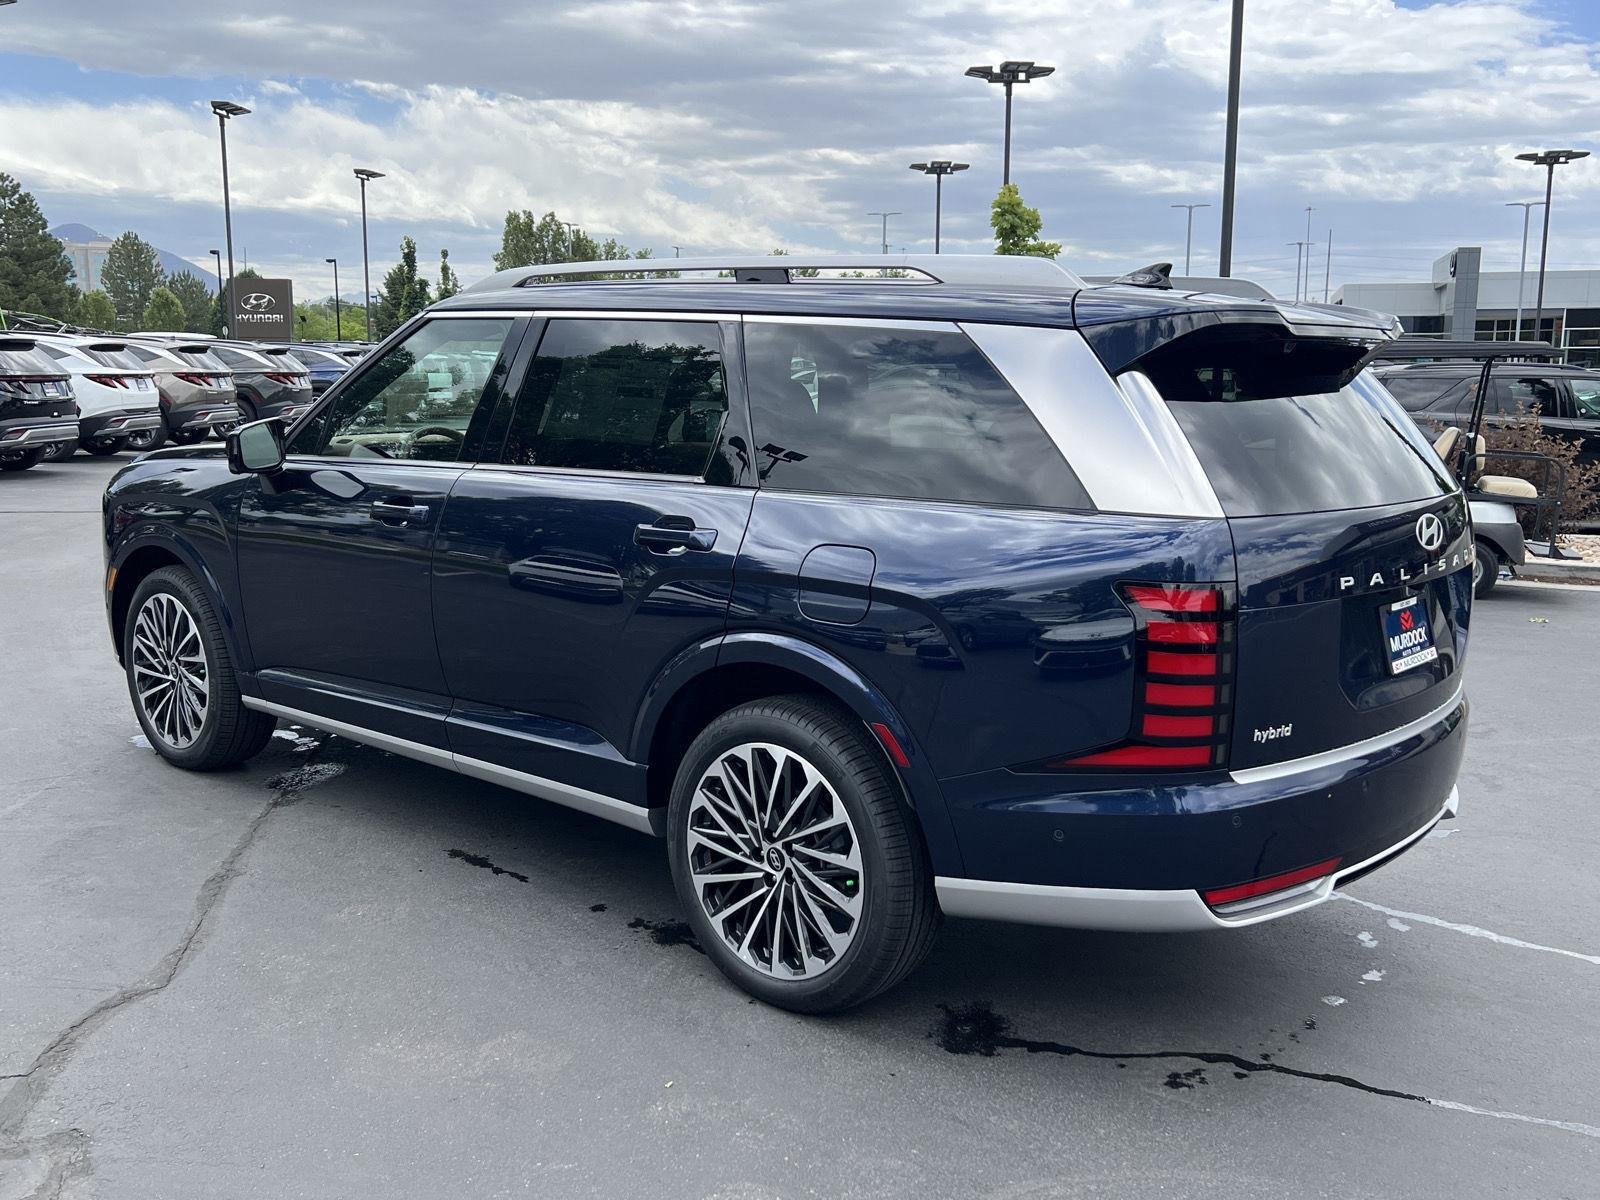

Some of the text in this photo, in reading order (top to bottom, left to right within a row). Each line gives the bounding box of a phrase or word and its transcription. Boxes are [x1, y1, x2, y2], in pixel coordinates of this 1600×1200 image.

[235, 314, 284, 323] HYUNDAI
[1340, 544, 1474, 590] PALISAD
[1390, 627, 1428, 652] MURDOCK
[1253, 723, 1293, 743] hybrid
